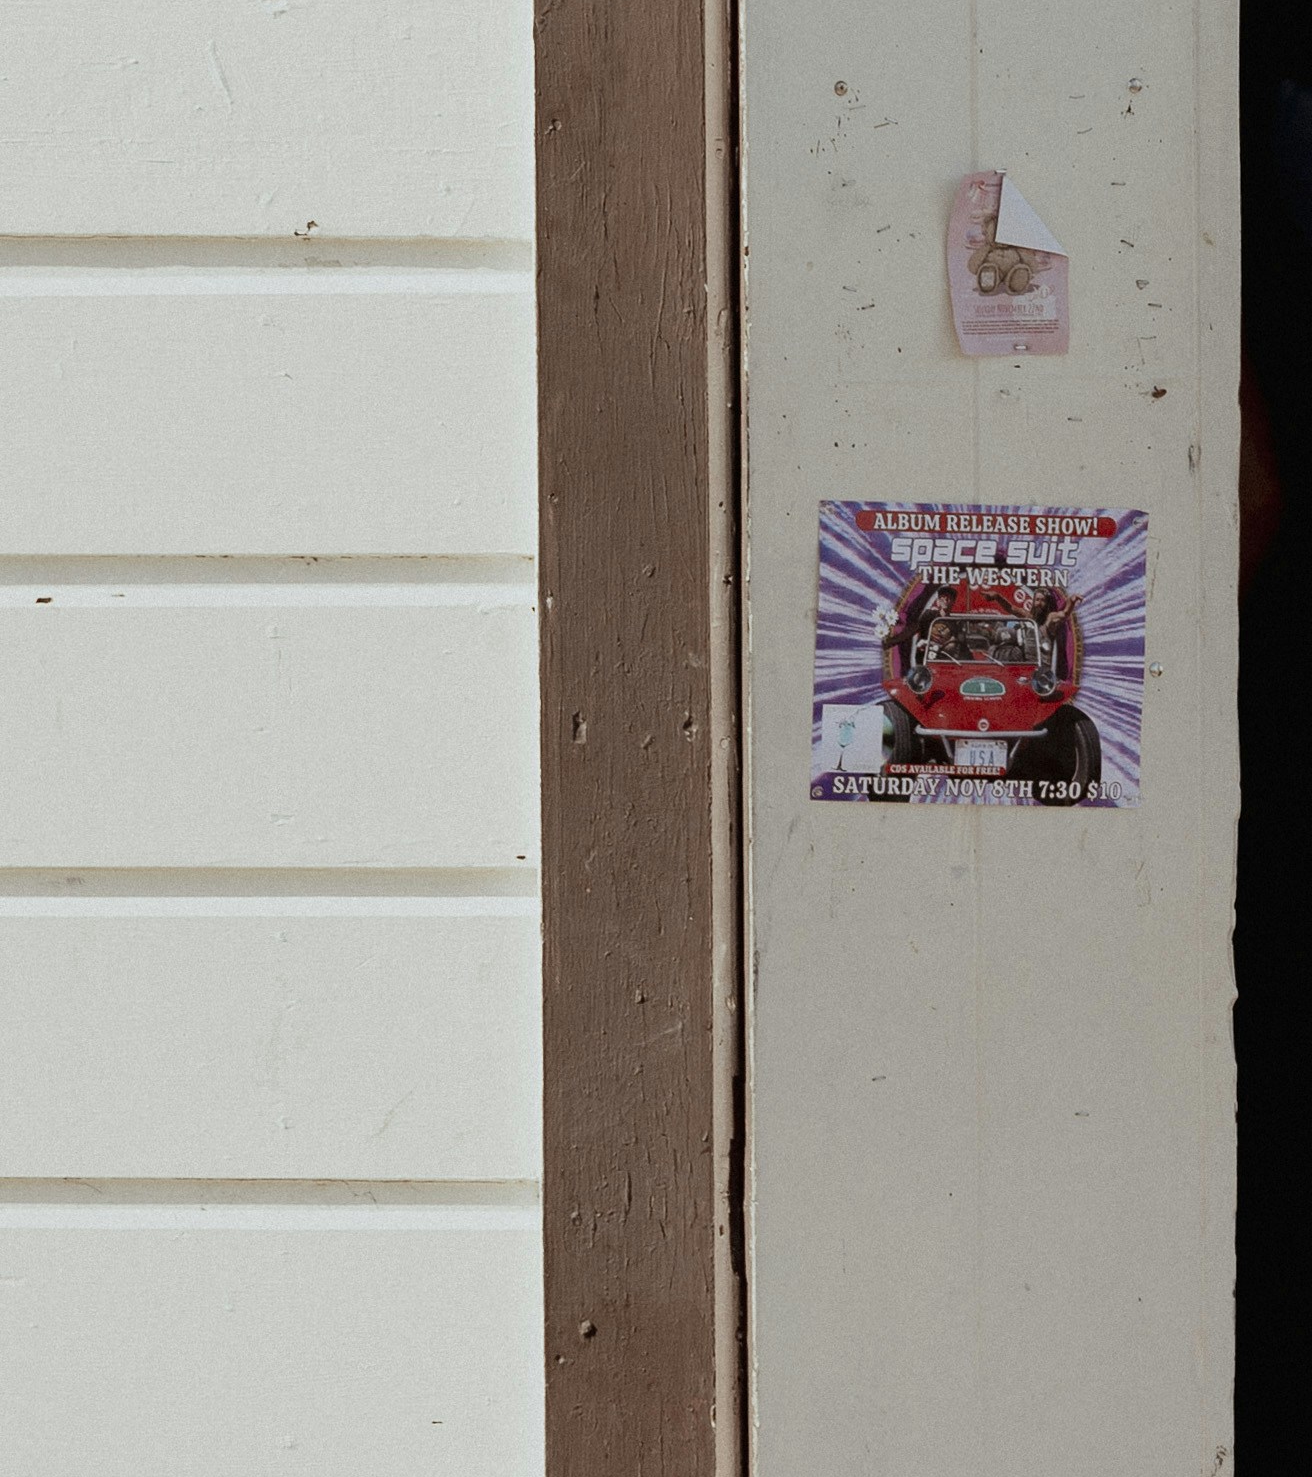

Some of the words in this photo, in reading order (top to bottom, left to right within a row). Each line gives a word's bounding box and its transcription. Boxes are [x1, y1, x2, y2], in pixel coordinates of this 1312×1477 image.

[873, 513, 940, 531] ALBUM
[946, 514, 1031, 534] RELEASE
[1035, 516, 1099, 536] SHOW!
[891, 537, 997, 569] space
[1005, 536, 1079, 566] suit
[918, 566, 960, 584] THE
[966, 568, 1069, 588] WESTERN
[908, 765, 955, 774] AVAILABLE
[956, 766, 974, 774] FOR
[832, 776, 936, 796] SATURDAY
[945, 778, 986, 797] NOV
[990, 779, 1034, 797] 8TH
[1039, 781, 1081, 799] 7:30
[1087, 781, 1122, 801] $10
